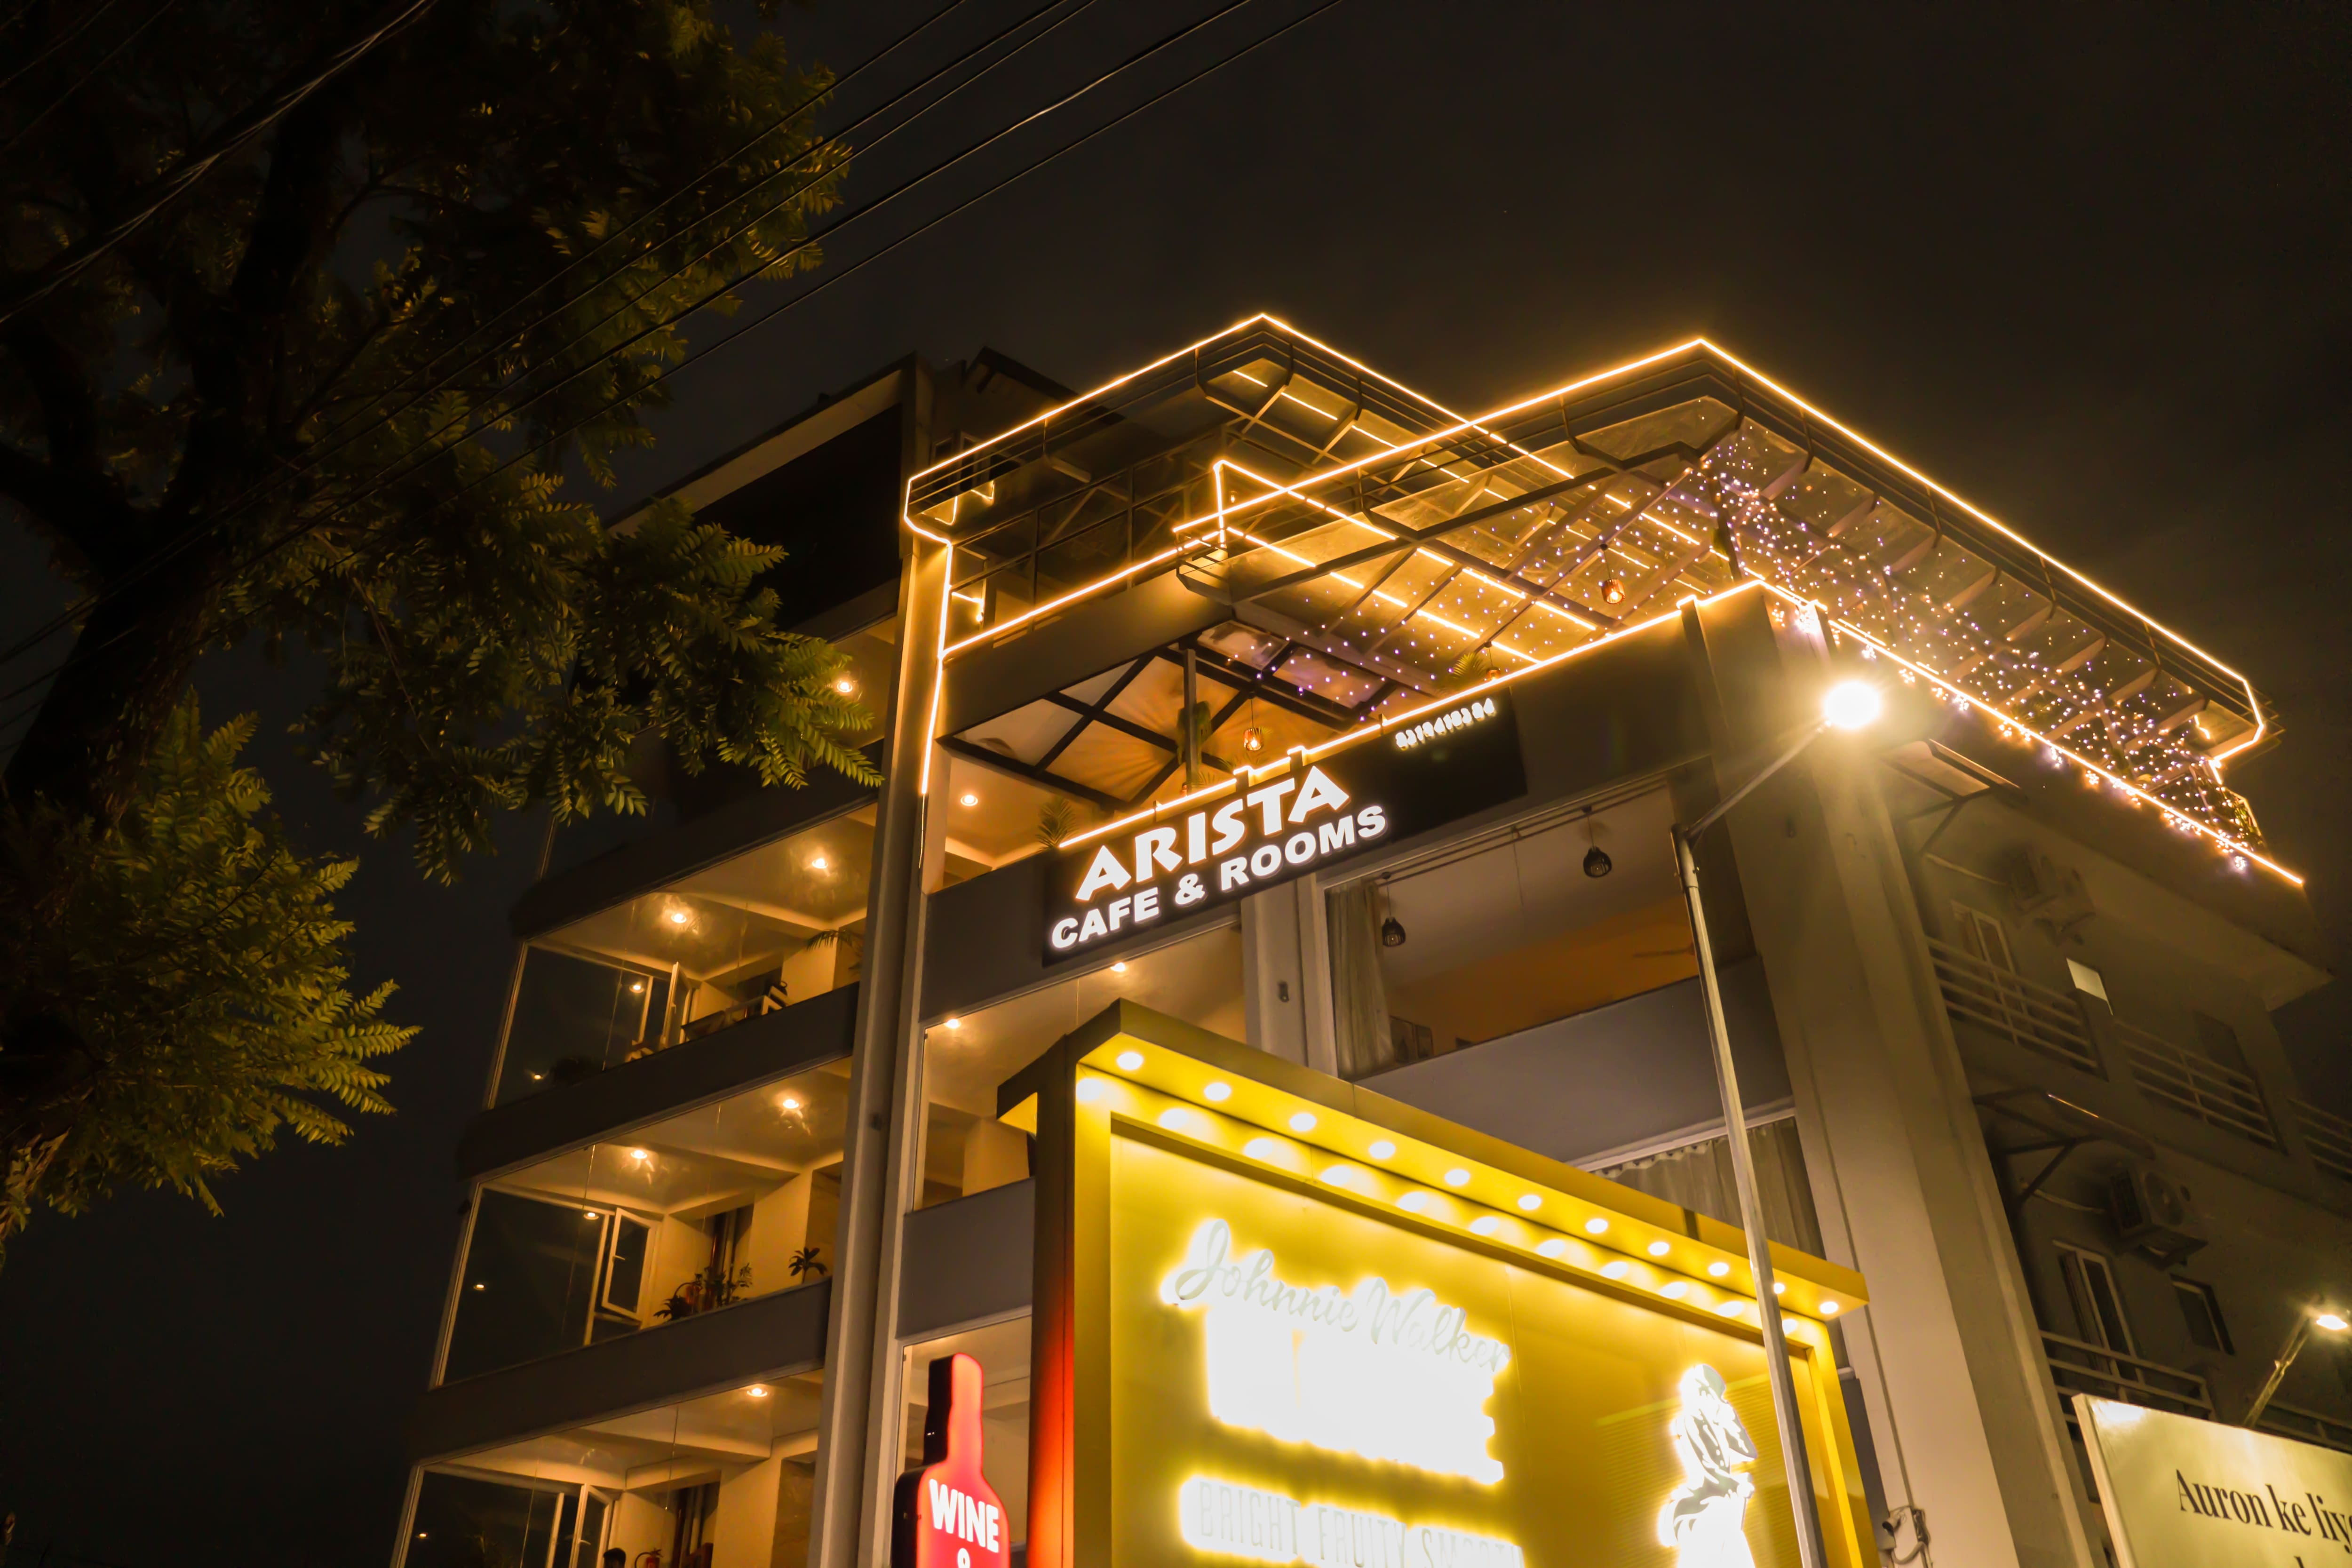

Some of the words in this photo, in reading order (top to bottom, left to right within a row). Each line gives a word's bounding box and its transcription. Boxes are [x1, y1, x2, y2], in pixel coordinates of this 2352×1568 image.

[1051, 887, 1160, 949] CAFE
[1175, 873, 1206, 906] &
[1220, 805, 1387, 891] ROOMS
[1075, 765, 1350, 901] ARISTA
[1174, 1219, 1359, 1332] Johnnie
[1365, 1276, 1511, 1372] Walker
[928, 1478, 999, 1553] WINE
[1199, 1481, 1302, 1556] BRIGHT
[1318, 1506, 1406, 1568] FRUITY
[2176, 1468, 2274, 1528] Auron
[2265, 1483, 2312, 1536] ke
[2305, 1492, 2352, 1554] liy
